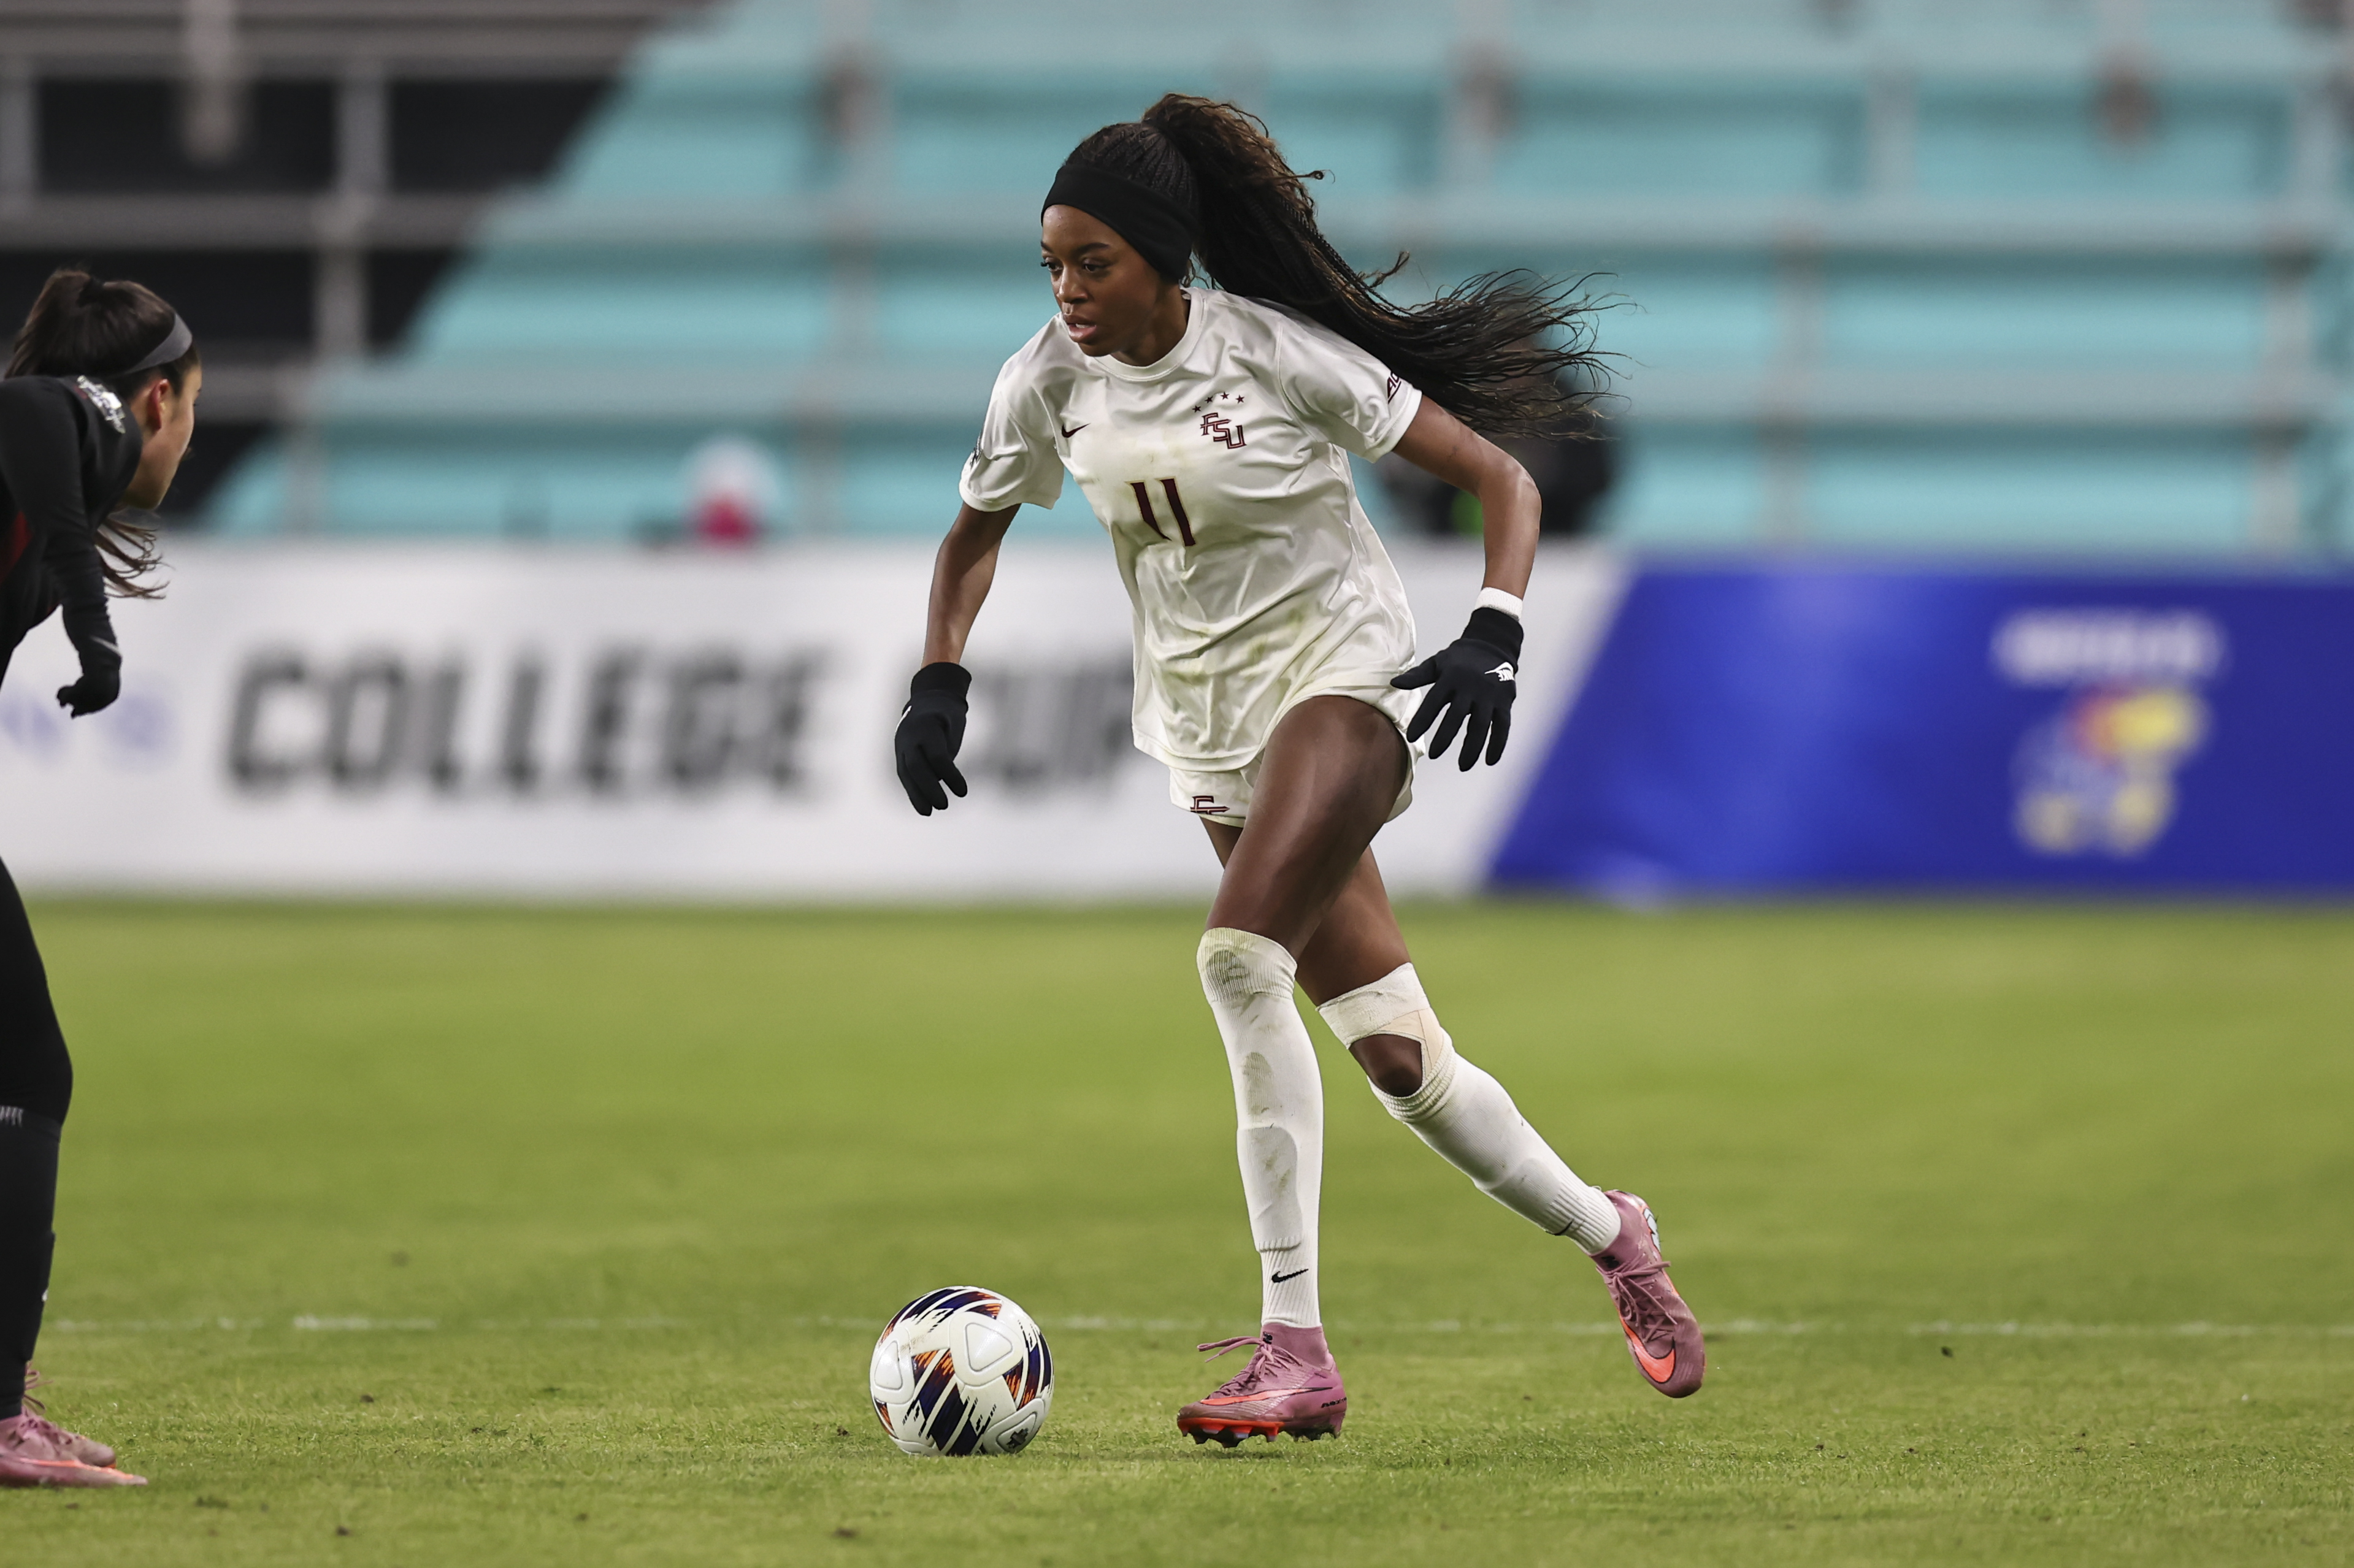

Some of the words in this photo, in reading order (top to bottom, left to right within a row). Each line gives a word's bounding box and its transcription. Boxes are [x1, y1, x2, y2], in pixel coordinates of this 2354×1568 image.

[1200, 412, 1248, 449] FSU
[1124, 476, 1196, 546] 11
[1496, 669, 1515, 681] NIKE
[226, 647, 831, 796] COLLEGE
